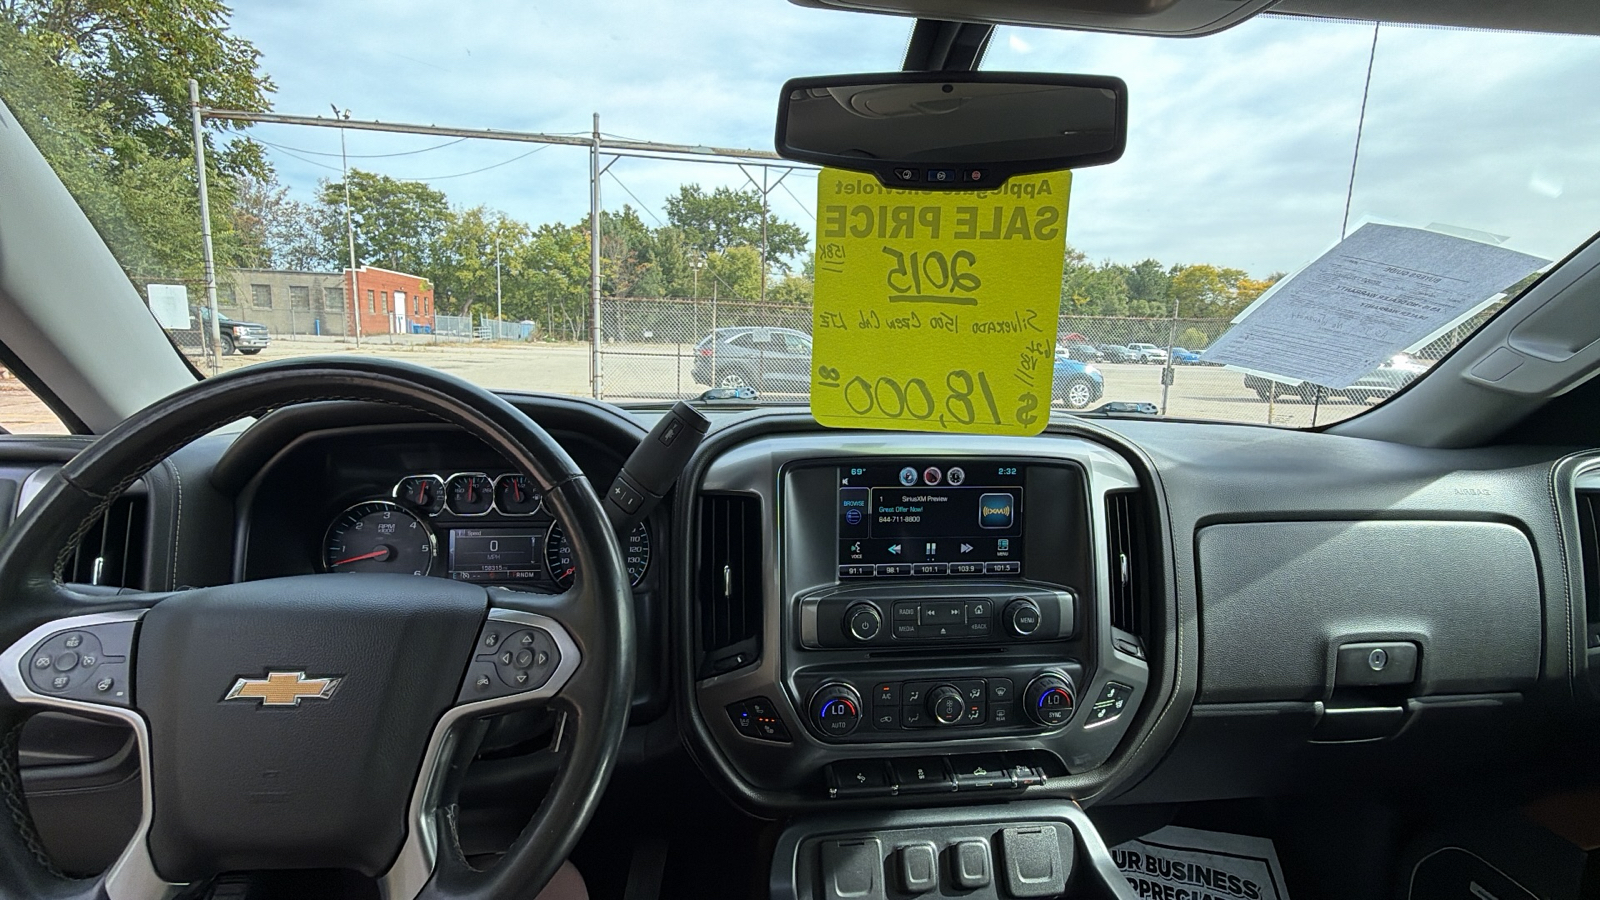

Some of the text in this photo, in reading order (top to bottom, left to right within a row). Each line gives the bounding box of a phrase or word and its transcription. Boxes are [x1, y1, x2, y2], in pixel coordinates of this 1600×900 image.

[355, 522, 364, 530] 2
[409, 521, 417, 529] 4
[489, 540, 499, 552] 0
[899, 608, 914, 616] RADIO
[1020, 616, 1035, 624] MENU
[898, 625, 915, 633] MEDIA
[54, 677, 68, 685] SET
[1047, 695, 1060, 705] LO
[831, 704, 844, 715] LO
[831, 721, 846, 729] AUTO
[1111, 850, 1261, 900] UR BUSINESS
